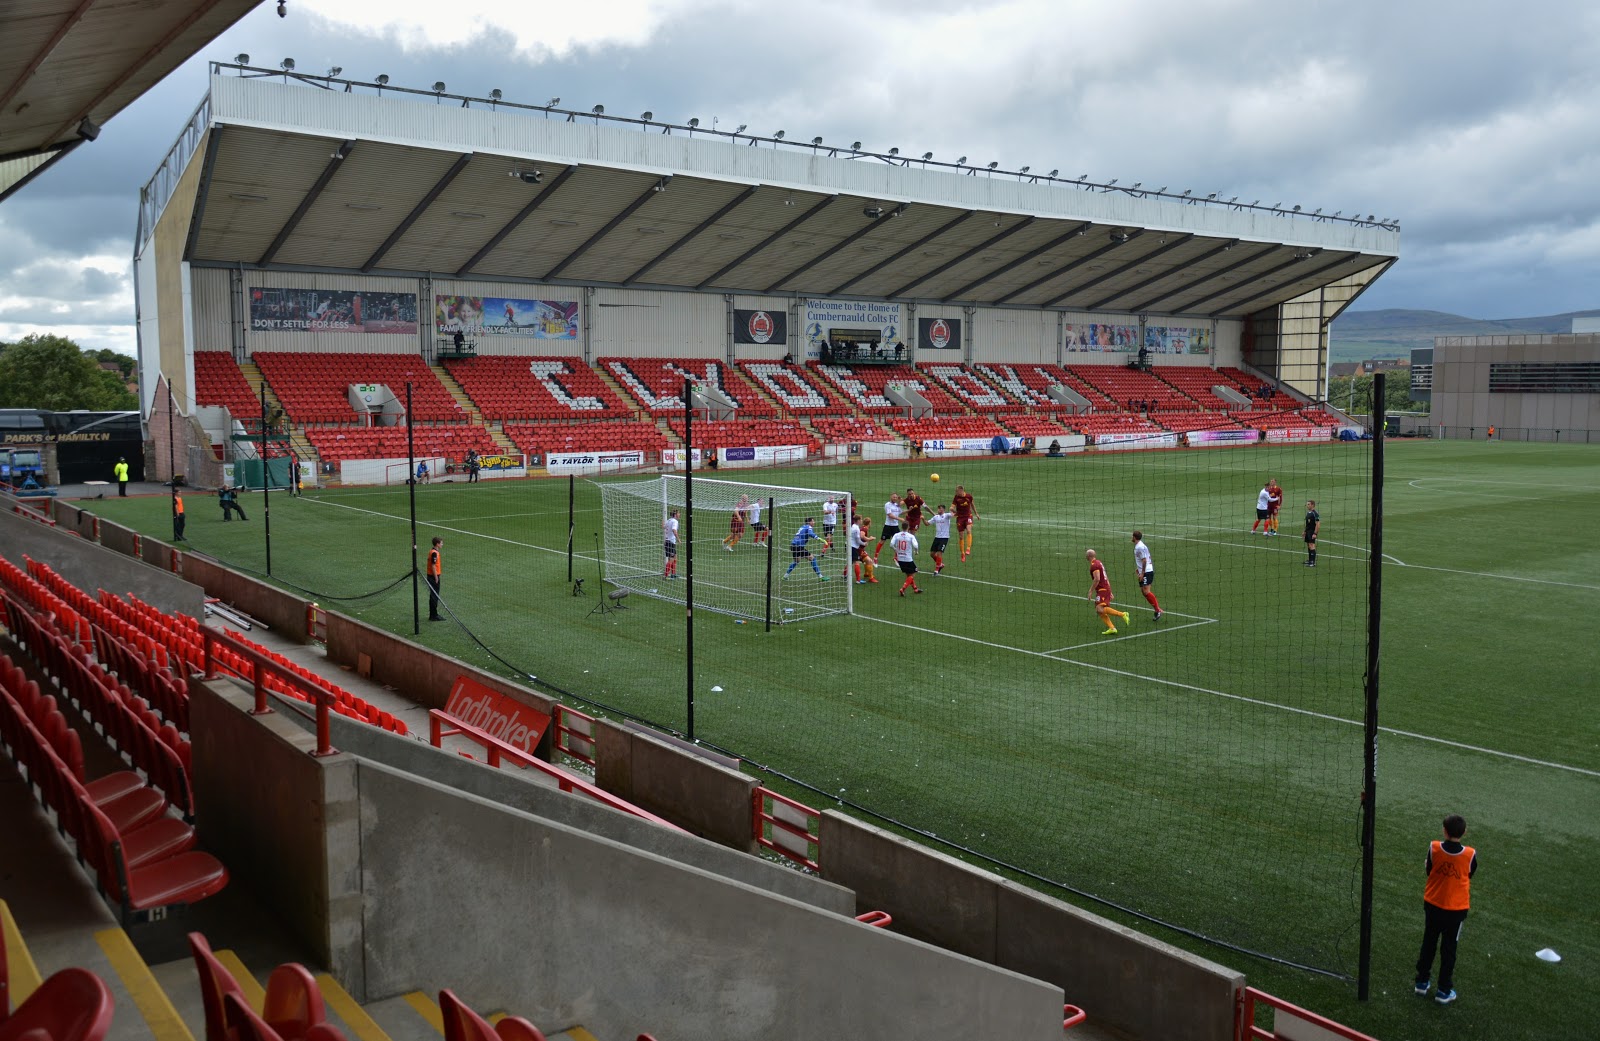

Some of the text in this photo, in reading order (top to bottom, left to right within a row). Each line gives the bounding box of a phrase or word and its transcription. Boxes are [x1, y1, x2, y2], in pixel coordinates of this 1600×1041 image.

[807, 300, 899, 312] Welcome to the Home of
[807, 311, 898, 324] Cumbernauld Colts FC
[254, 319, 349, 330] DON'T SETTLE FOR LESS
[440, 324, 466, 333] FAMILY
[467, 325, 498, 334] FRIENDLY
[4, 434, 42, 442] PARK'S
[58, 433, 110, 441] HAMILTON
[897, 540, 907, 551] 10
[447, 683, 539, 754] Ladbrokes
